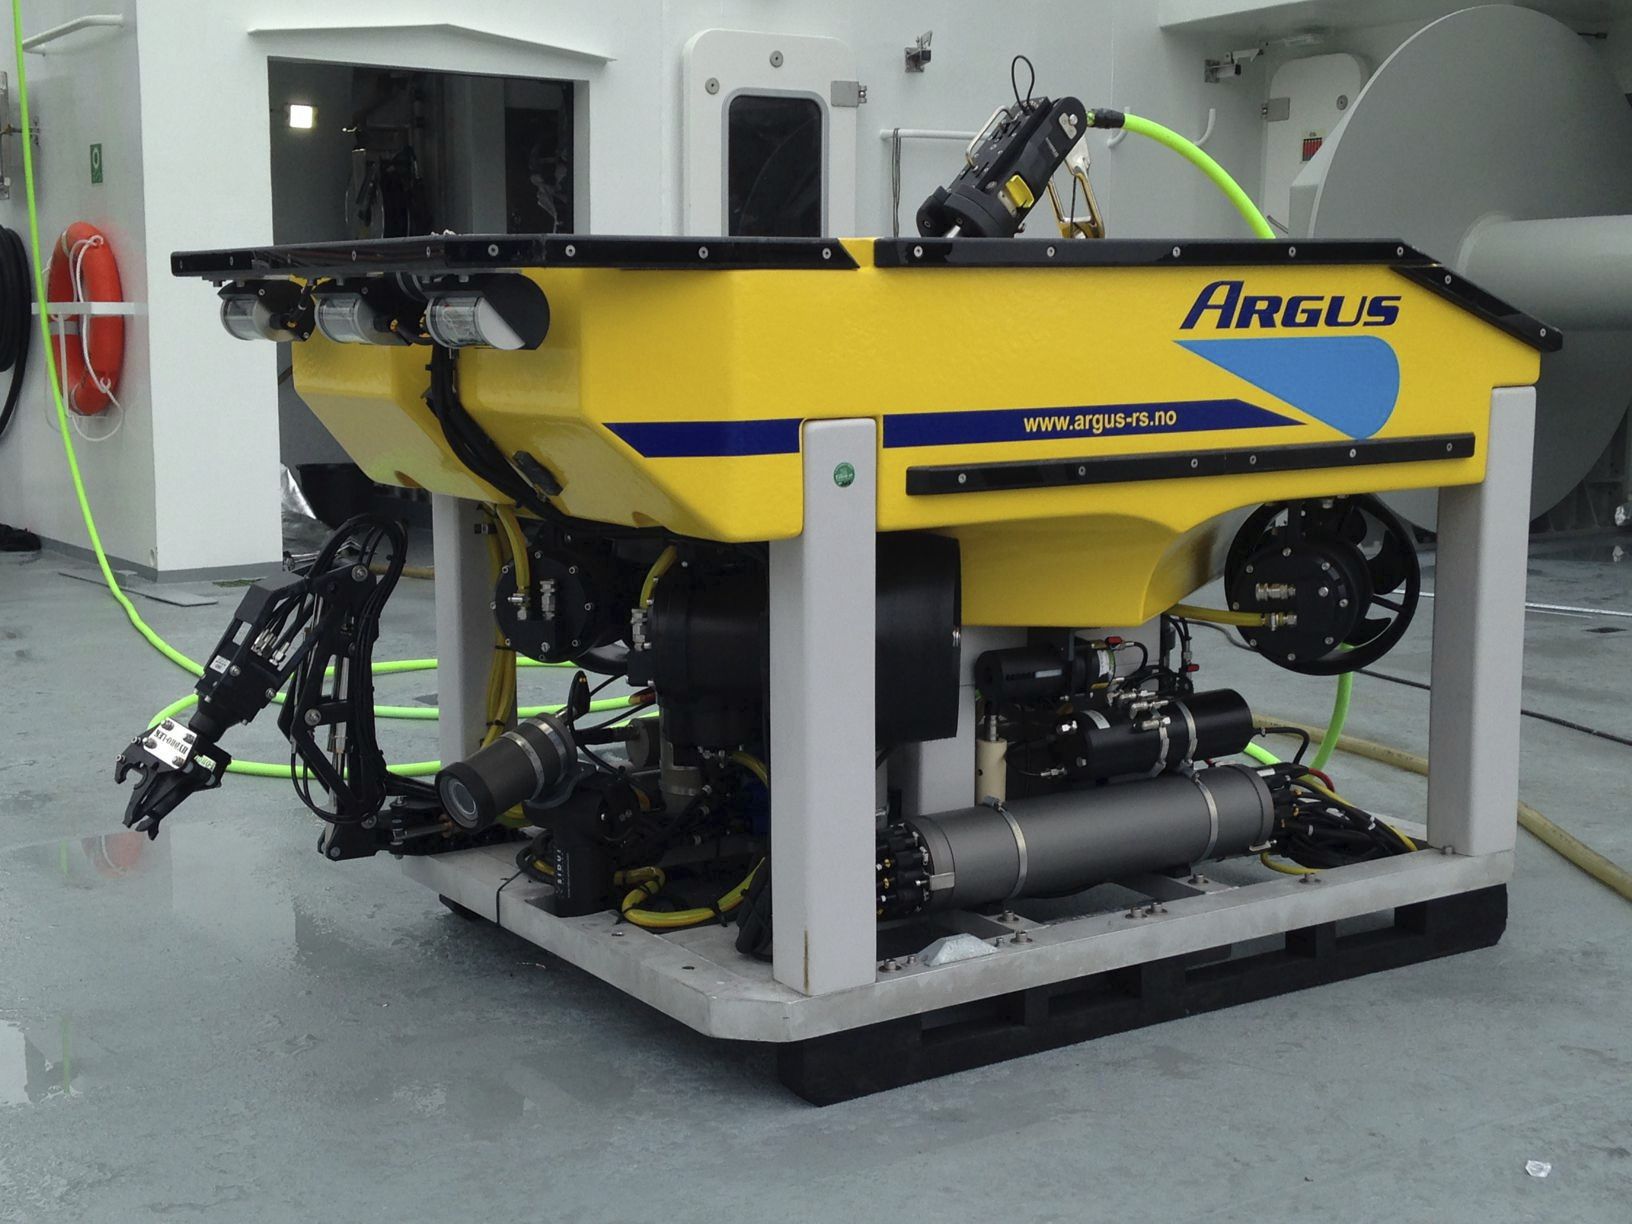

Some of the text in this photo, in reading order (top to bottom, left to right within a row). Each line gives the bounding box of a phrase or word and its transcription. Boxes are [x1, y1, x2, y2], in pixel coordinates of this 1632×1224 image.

[1179, 281, 1401, 329] ARGUS
[1024, 409, 1177, 435] www.argus-rs.no
[154, 729, 189, 755] HYDRO-LEK
